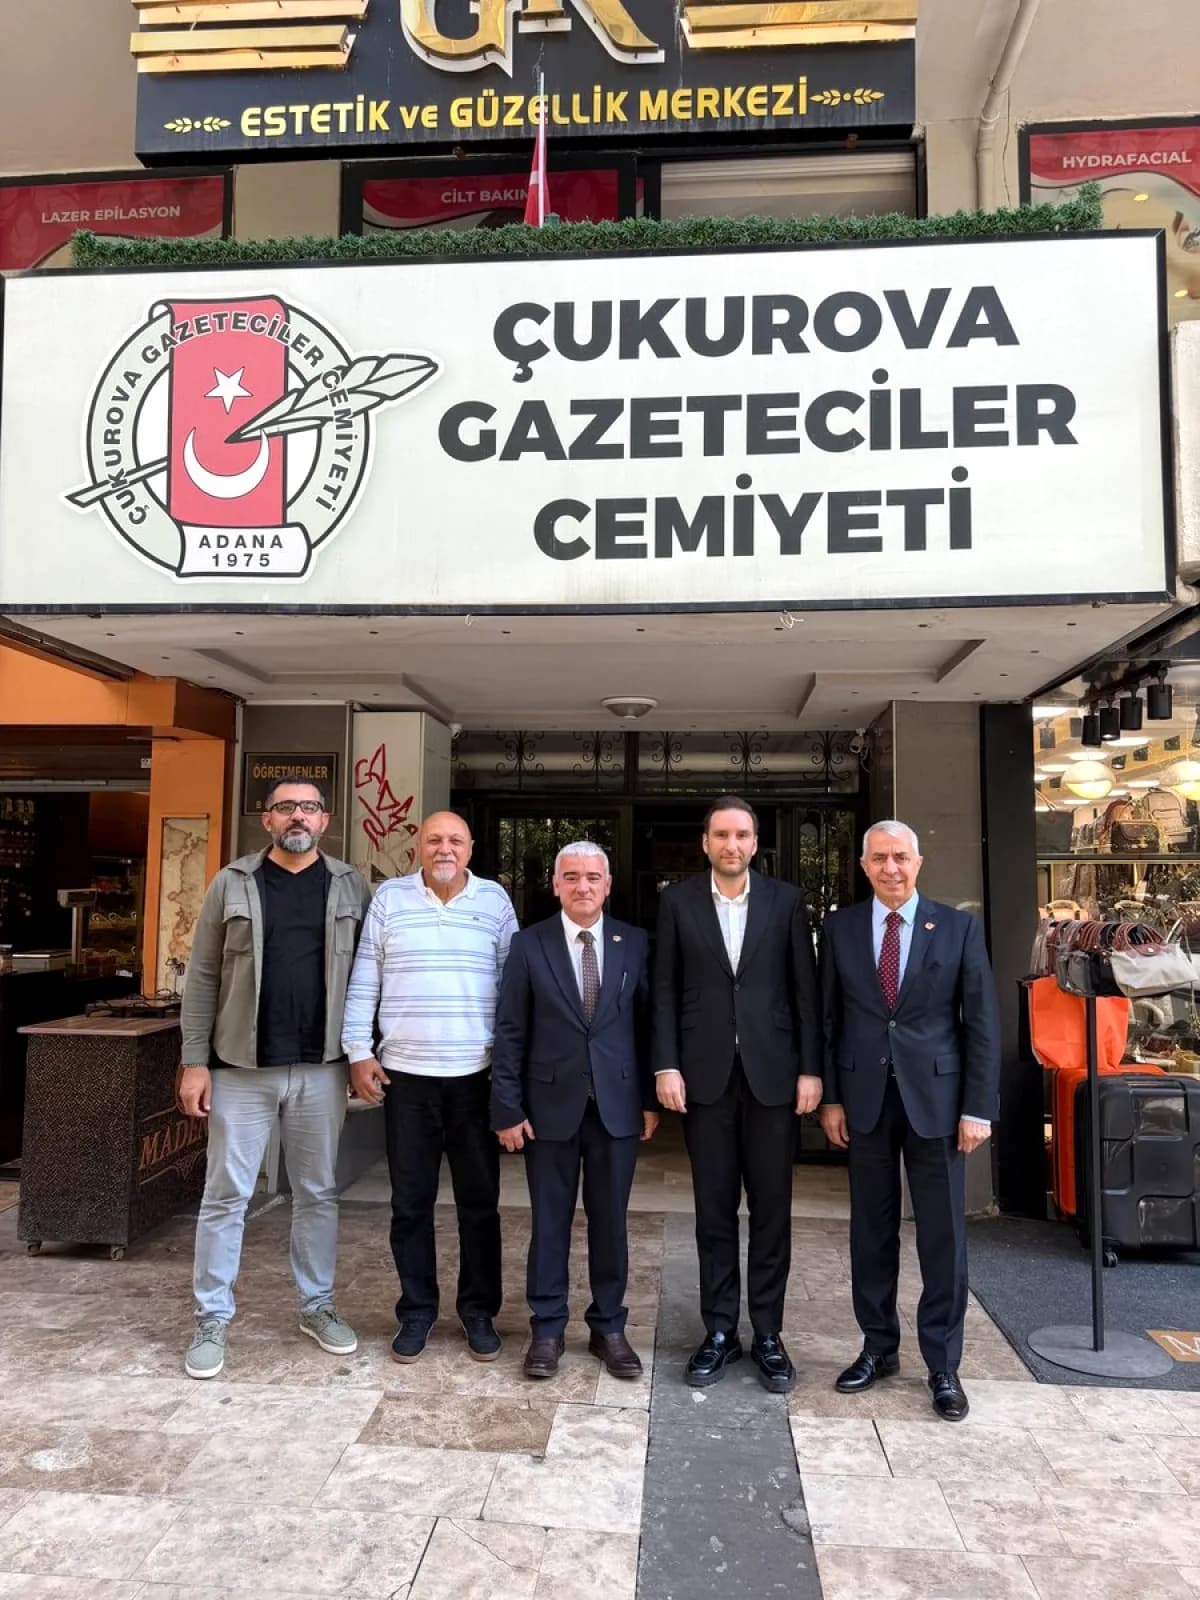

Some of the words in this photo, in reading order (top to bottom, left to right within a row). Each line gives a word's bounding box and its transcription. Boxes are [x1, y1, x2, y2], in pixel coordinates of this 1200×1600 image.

[240, 94, 391, 136] ESTETİK
[450, 88, 628, 128] GÜZELLİK
[639, 76, 807, 121] MERKEZİ
[1062, 151, 1192, 169] HYDRAFACIAL
[41, 210, 90, 224] LAZER
[95, 205, 181, 222] EPİLASYON
[441, 188, 476, 204] CİLT
[493, 285, 1020, 383] ÇUKUROVA
[103, 369, 148, 525] ÇUKUROVA
[142, 312, 325, 367] GAZETECİLER
[321, 369, 359, 513] CEMİYETİ
[438, 368, 1079, 463] GAZETECİLER
[533, 465, 972, 561] CEMİYETİ
[198, 534, 284, 549] ADANA
[212, 553, 271, 568] 1975
